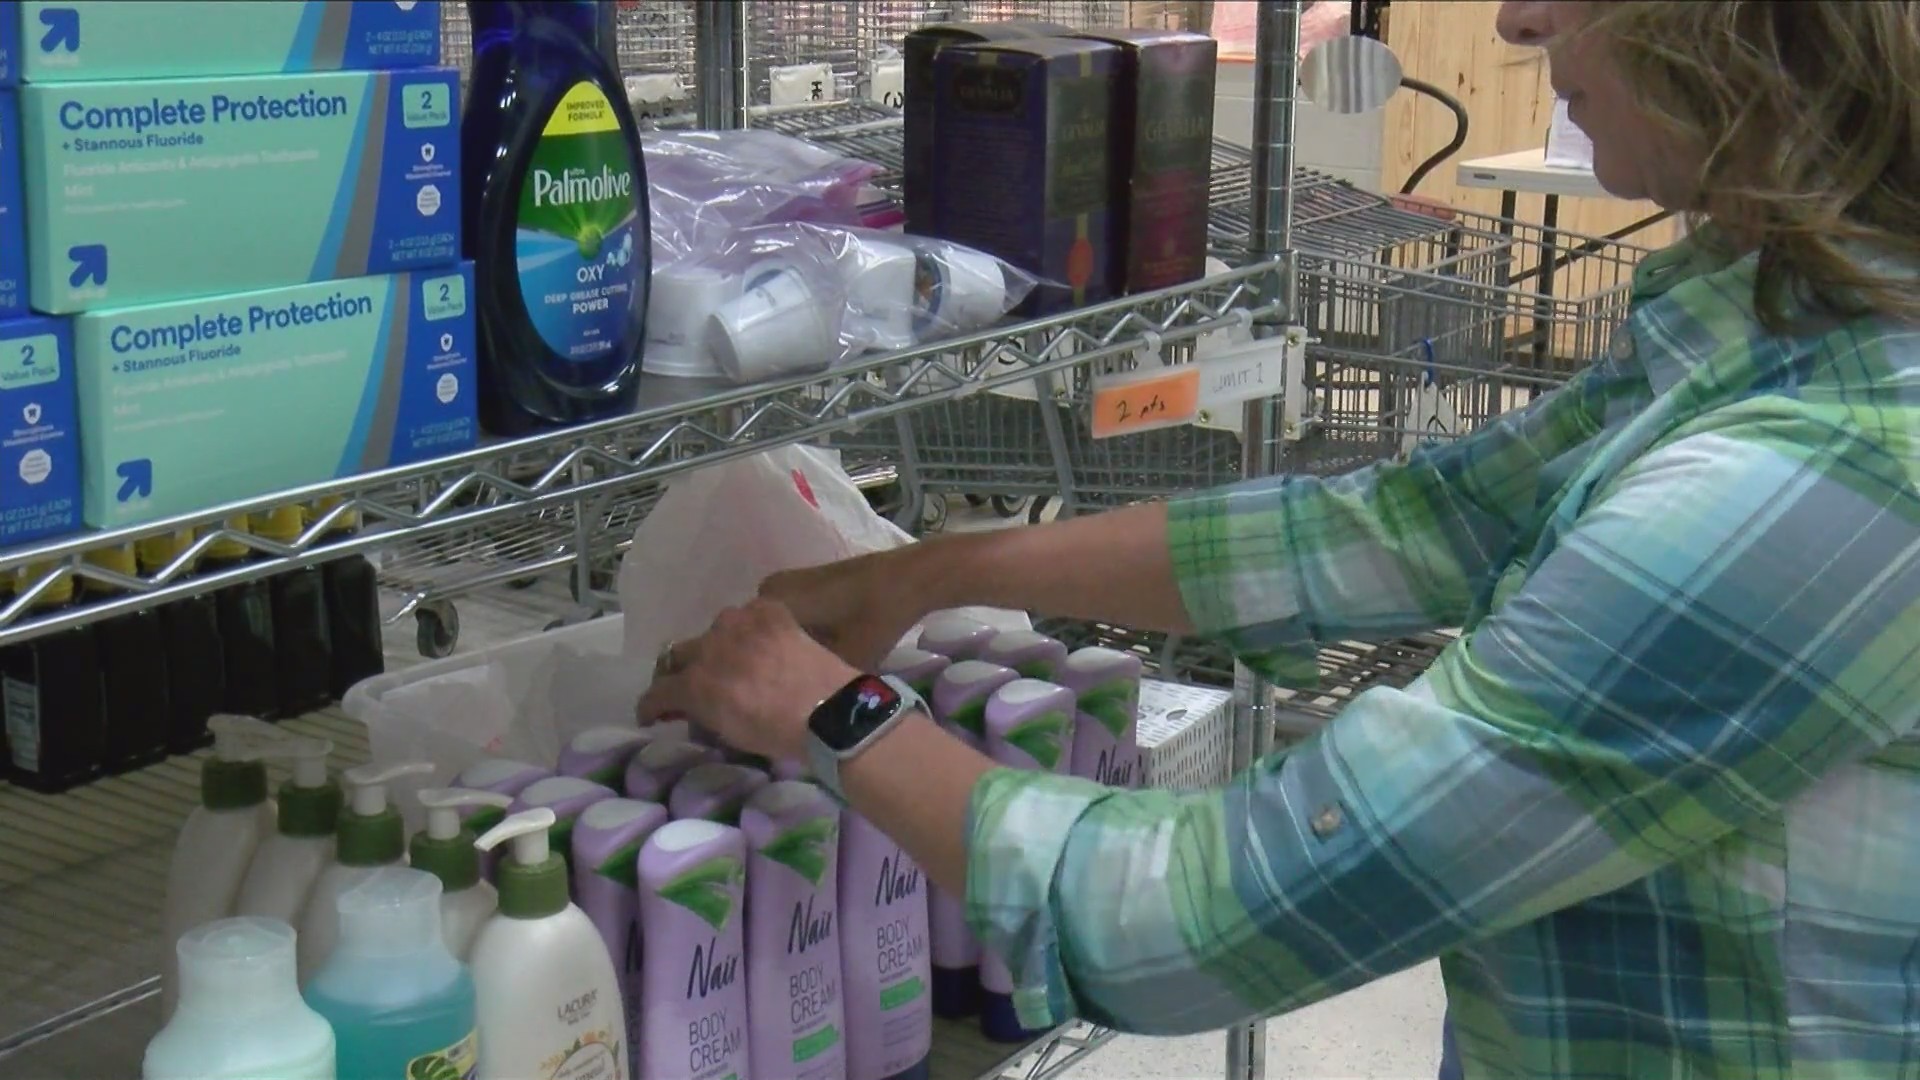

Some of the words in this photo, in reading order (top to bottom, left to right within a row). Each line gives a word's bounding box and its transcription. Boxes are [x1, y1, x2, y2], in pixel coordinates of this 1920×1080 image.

[60, 98, 206, 133] Complete
[212, 89, 346, 122] Protection
[421, 90, 432, 110] 2
[566, 100, 605, 111] IMPROVED
[75, 138, 143, 151] Stannous
[146, 132, 203, 147] Fluoride
[534, 163, 631, 207] Palmolive
[576, 264, 605, 283] OXY
[440, 283, 450, 302] 2
[544, 293, 568, 304] DEEP
[569, 288, 600, 301] GREASE
[572, 298, 609, 314] POWER
[111, 313, 243, 353] Complete
[248, 292, 372, 333] Protection
[21, 344, 35, 366] 2
[123, 354, 187, 373] Stannous
[188, 344, 242, 361] Fluoride
[1116, 400, 1132, 423] 2
[1096, 743, 1133, 787] Nair
[876, 848, 920, 907] Nair
[788, 894, 833, 954] Nair
[877, 916, 910, 949] BODY
[687, 936, 738, 1000] Nair
[877, 934, 923, 975] CREAM
[789, 962, 824, 999] BODY
[790, 980, 837, 1025] CREAM
[688, 1007, 728, 1047] BODY
[690, 1027, 742, 1073] CREAM
